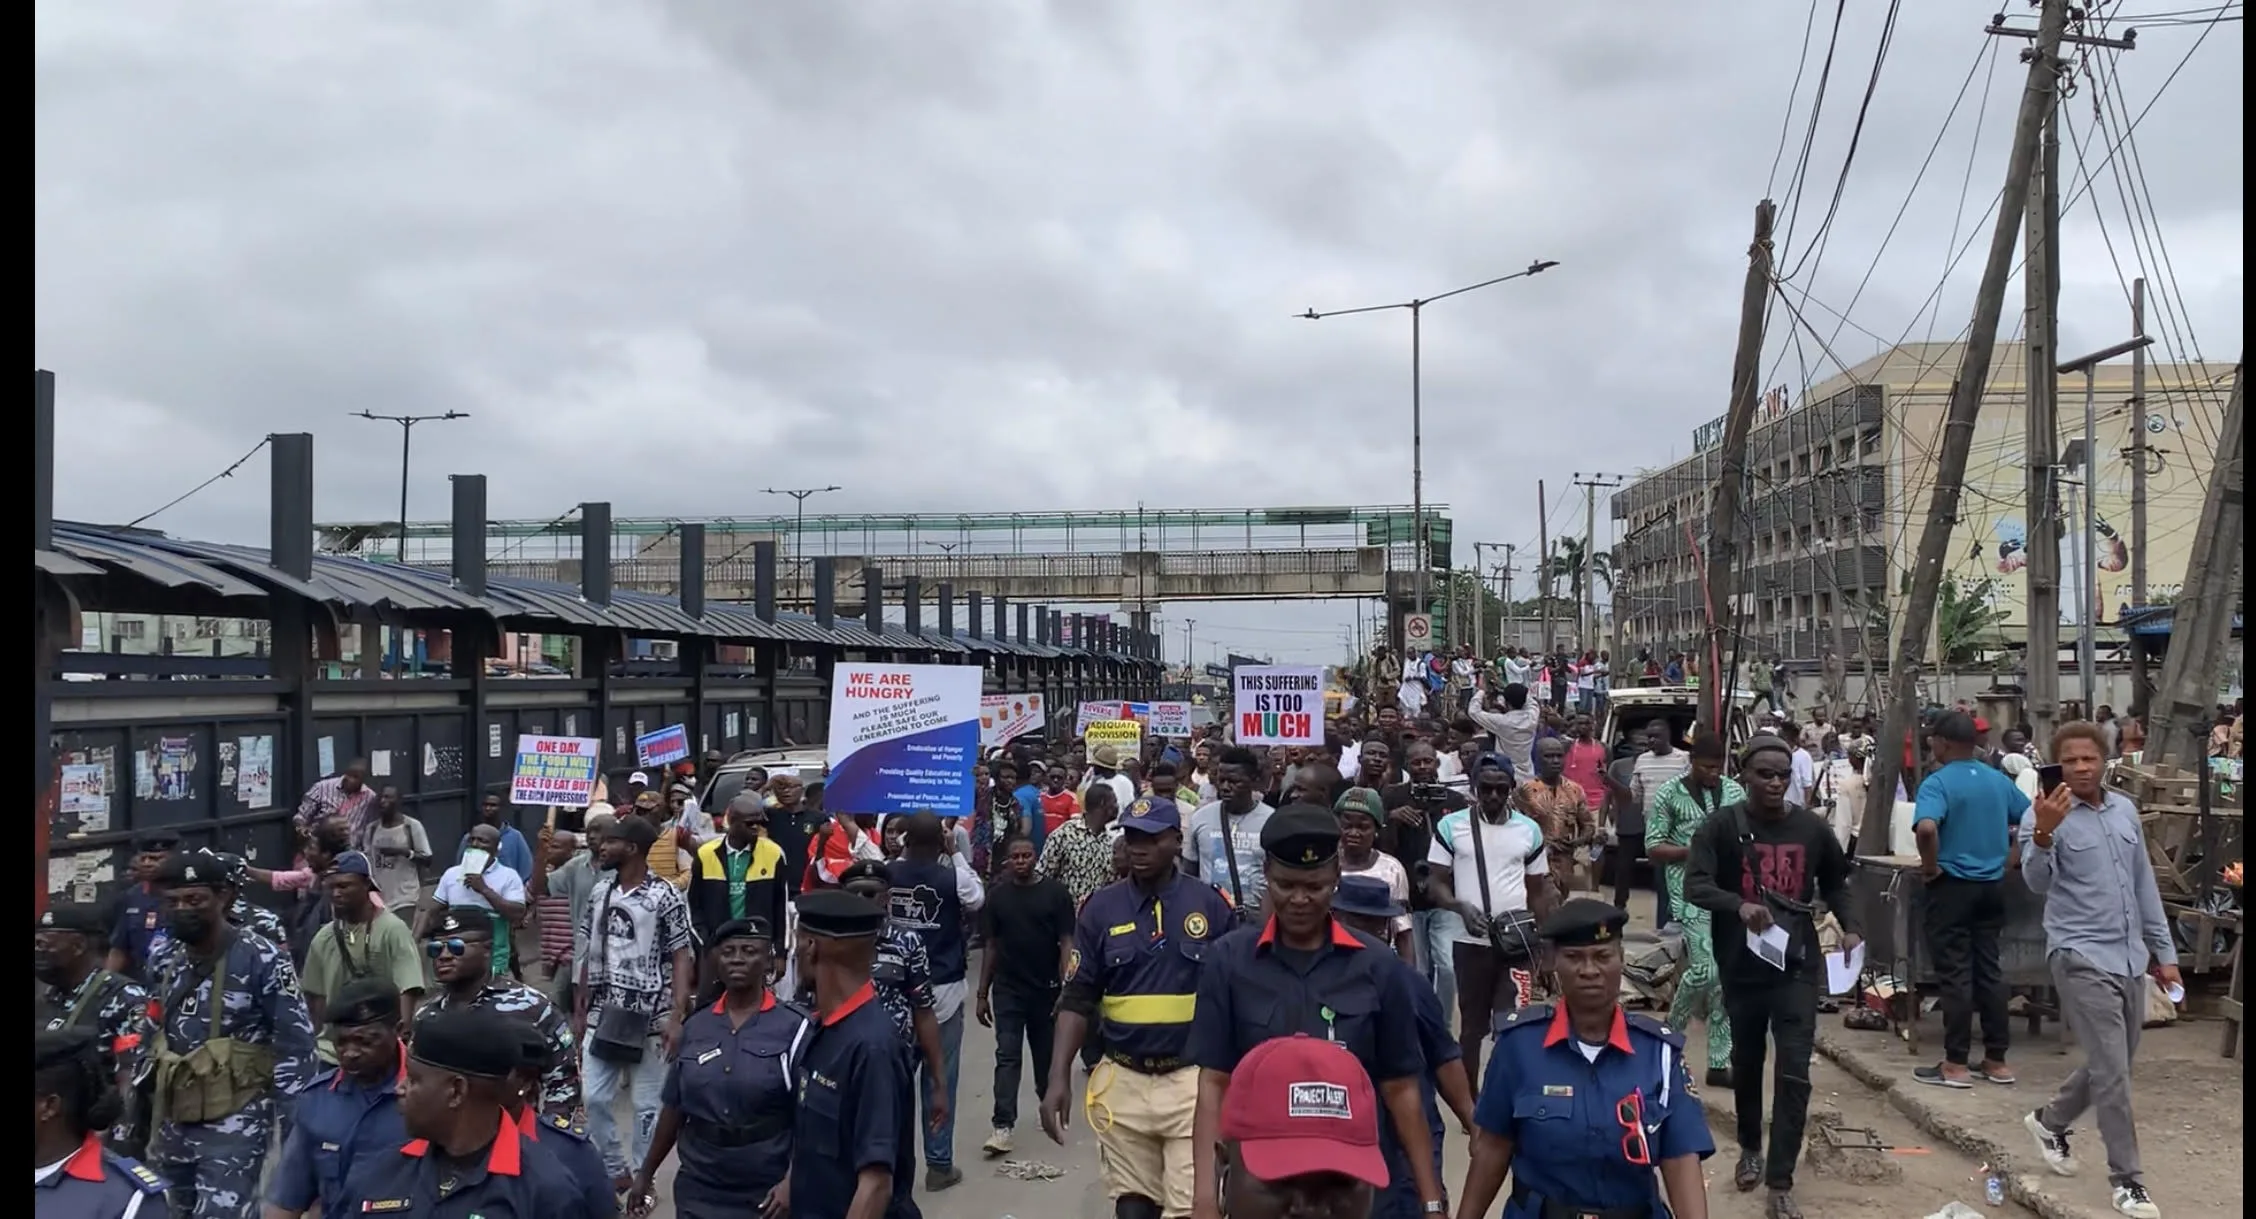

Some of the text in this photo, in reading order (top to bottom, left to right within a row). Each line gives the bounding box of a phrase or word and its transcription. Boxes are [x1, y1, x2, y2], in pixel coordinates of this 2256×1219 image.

[850, 673, 911, 685] WE ARE
[1240, 675, 1317, 690] THIS SUFFERING
[845, 686, 914, 699] HUNGRY
[853, 694, 941, 720] AND THE SUFFERING
[1255, 694, 1303, 712] IS TOO
[861, 710, 939, 733] PLEASE SAFE OUR
[880, 708, 916, 722] IS MUCH
[853, 715, 948, 743] GENERATION TO COME
[1090, 721, 1135, 730] ADEQUATE
[1243, 712, 1311, 738] MUCH
[1088, 730, 1137, 739] PROVISION
[536, 741, 558, 753] ONE
[522, 754, 592, 768] THE POOR WILL
[518, 765, 589, 778] HAVE NOTHING
[515, 777, 592, 791] ELSE TO EAT BUT
[515, 790, 527, 800] THE
[546, 791, 588, 803] OPPRESSORS
[1293, 1086, 1345, 1105] PROJECT ALERT
